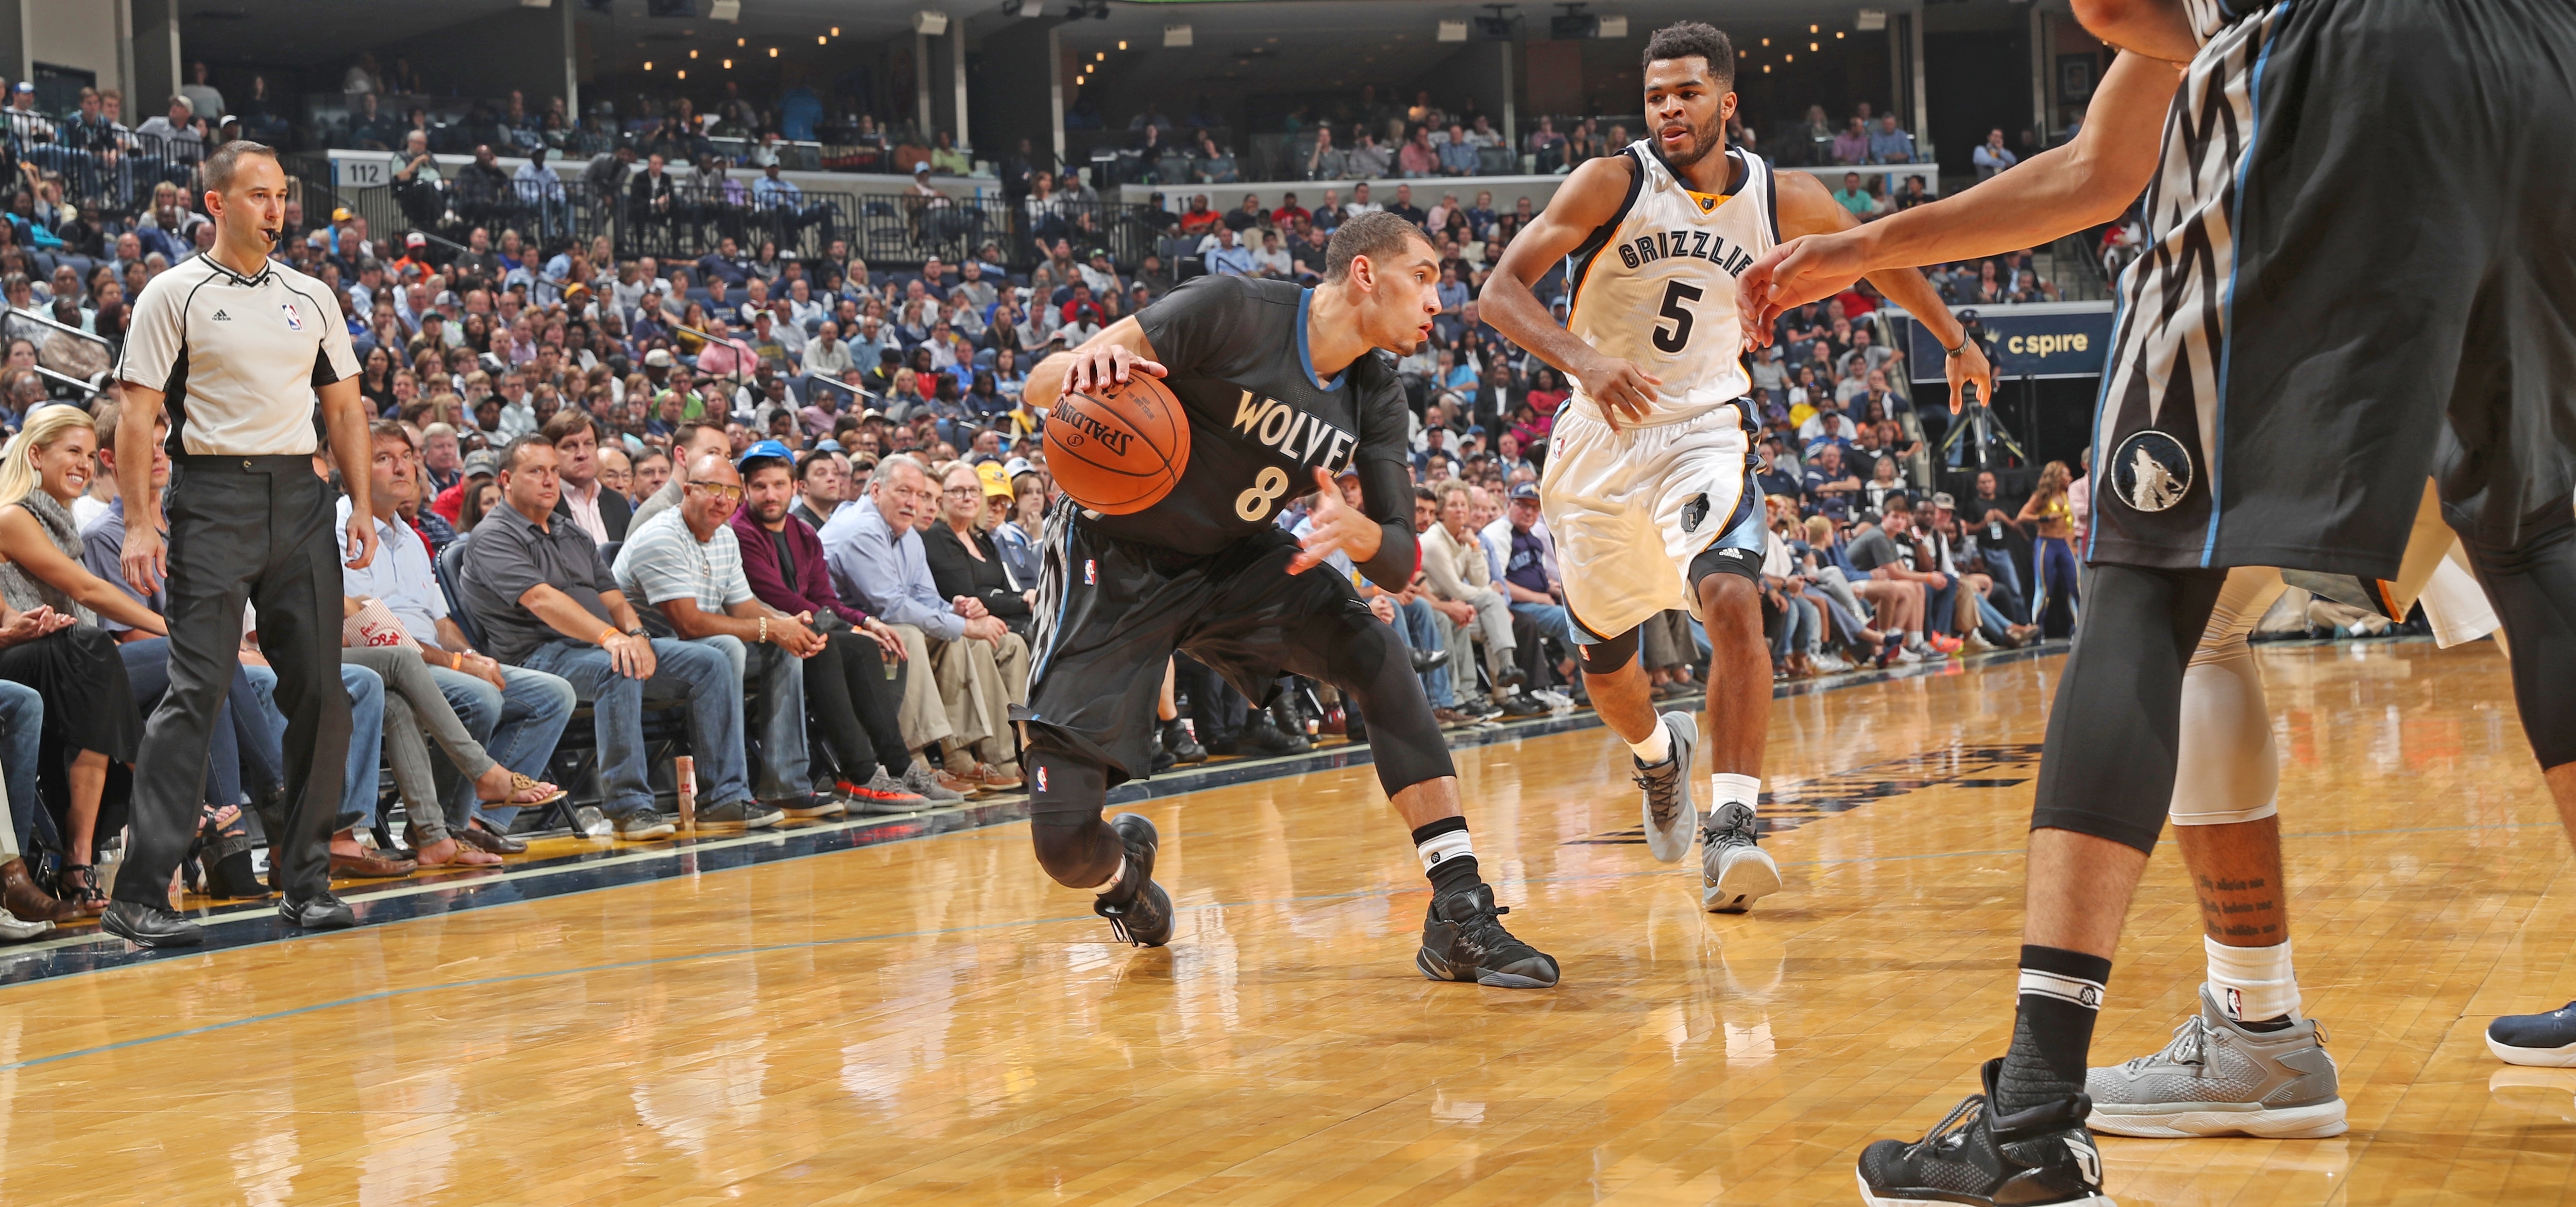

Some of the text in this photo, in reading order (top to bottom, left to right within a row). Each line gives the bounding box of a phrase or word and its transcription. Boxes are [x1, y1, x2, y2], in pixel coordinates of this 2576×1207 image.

[350, 164, 379, 182] 112
[1652, 280, 1703, 353] 5
[1050, 397, 1134, 457] SPALDING
[1235, 466, 1289, 522] 8
[1718, 551, 1743, 560] adidas
